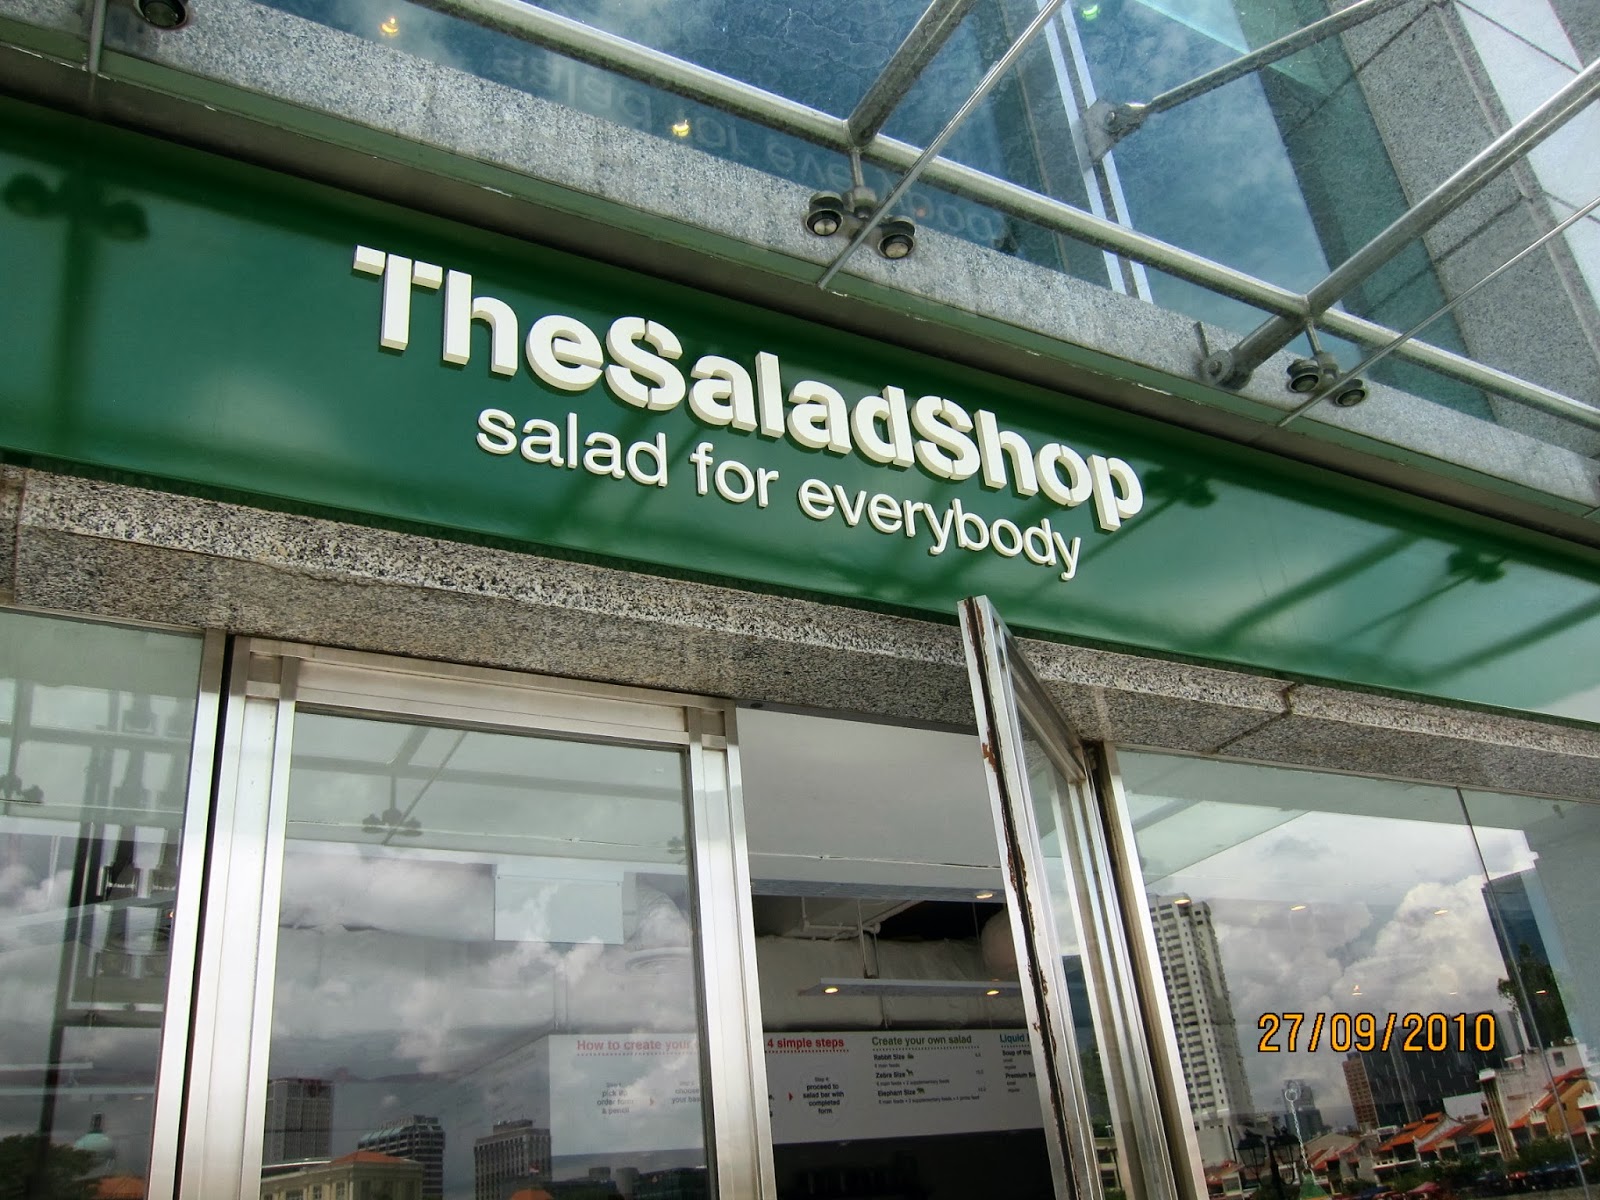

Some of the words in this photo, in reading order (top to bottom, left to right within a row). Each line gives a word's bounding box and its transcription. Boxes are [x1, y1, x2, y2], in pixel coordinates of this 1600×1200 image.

[353, 245, 1143, 531] TheSaladShop
[476, 408, 668, 487] salad
[690, 442, 779, 507] for
[799, 478, 1081, 580] everybody
[577, 1040, 604, 1051] How
[608, 1040, 620, 1051] to
[624, 1040, 661, 1051] create
[665, 1040, 691, 1053] your
[767, 1039, 774, 1048] 4
[777, 1038, 812, 1050] simple
[815, 1037, 845, 1049] steps
[871, 1036, 902, 1046] Create
[905, 1036, 926, 1047] your
[928, 1036, 946, 1045] own
[949, 1034, 972, 1044] salad
[1000, 1034, 1025, 1047] Liquid
